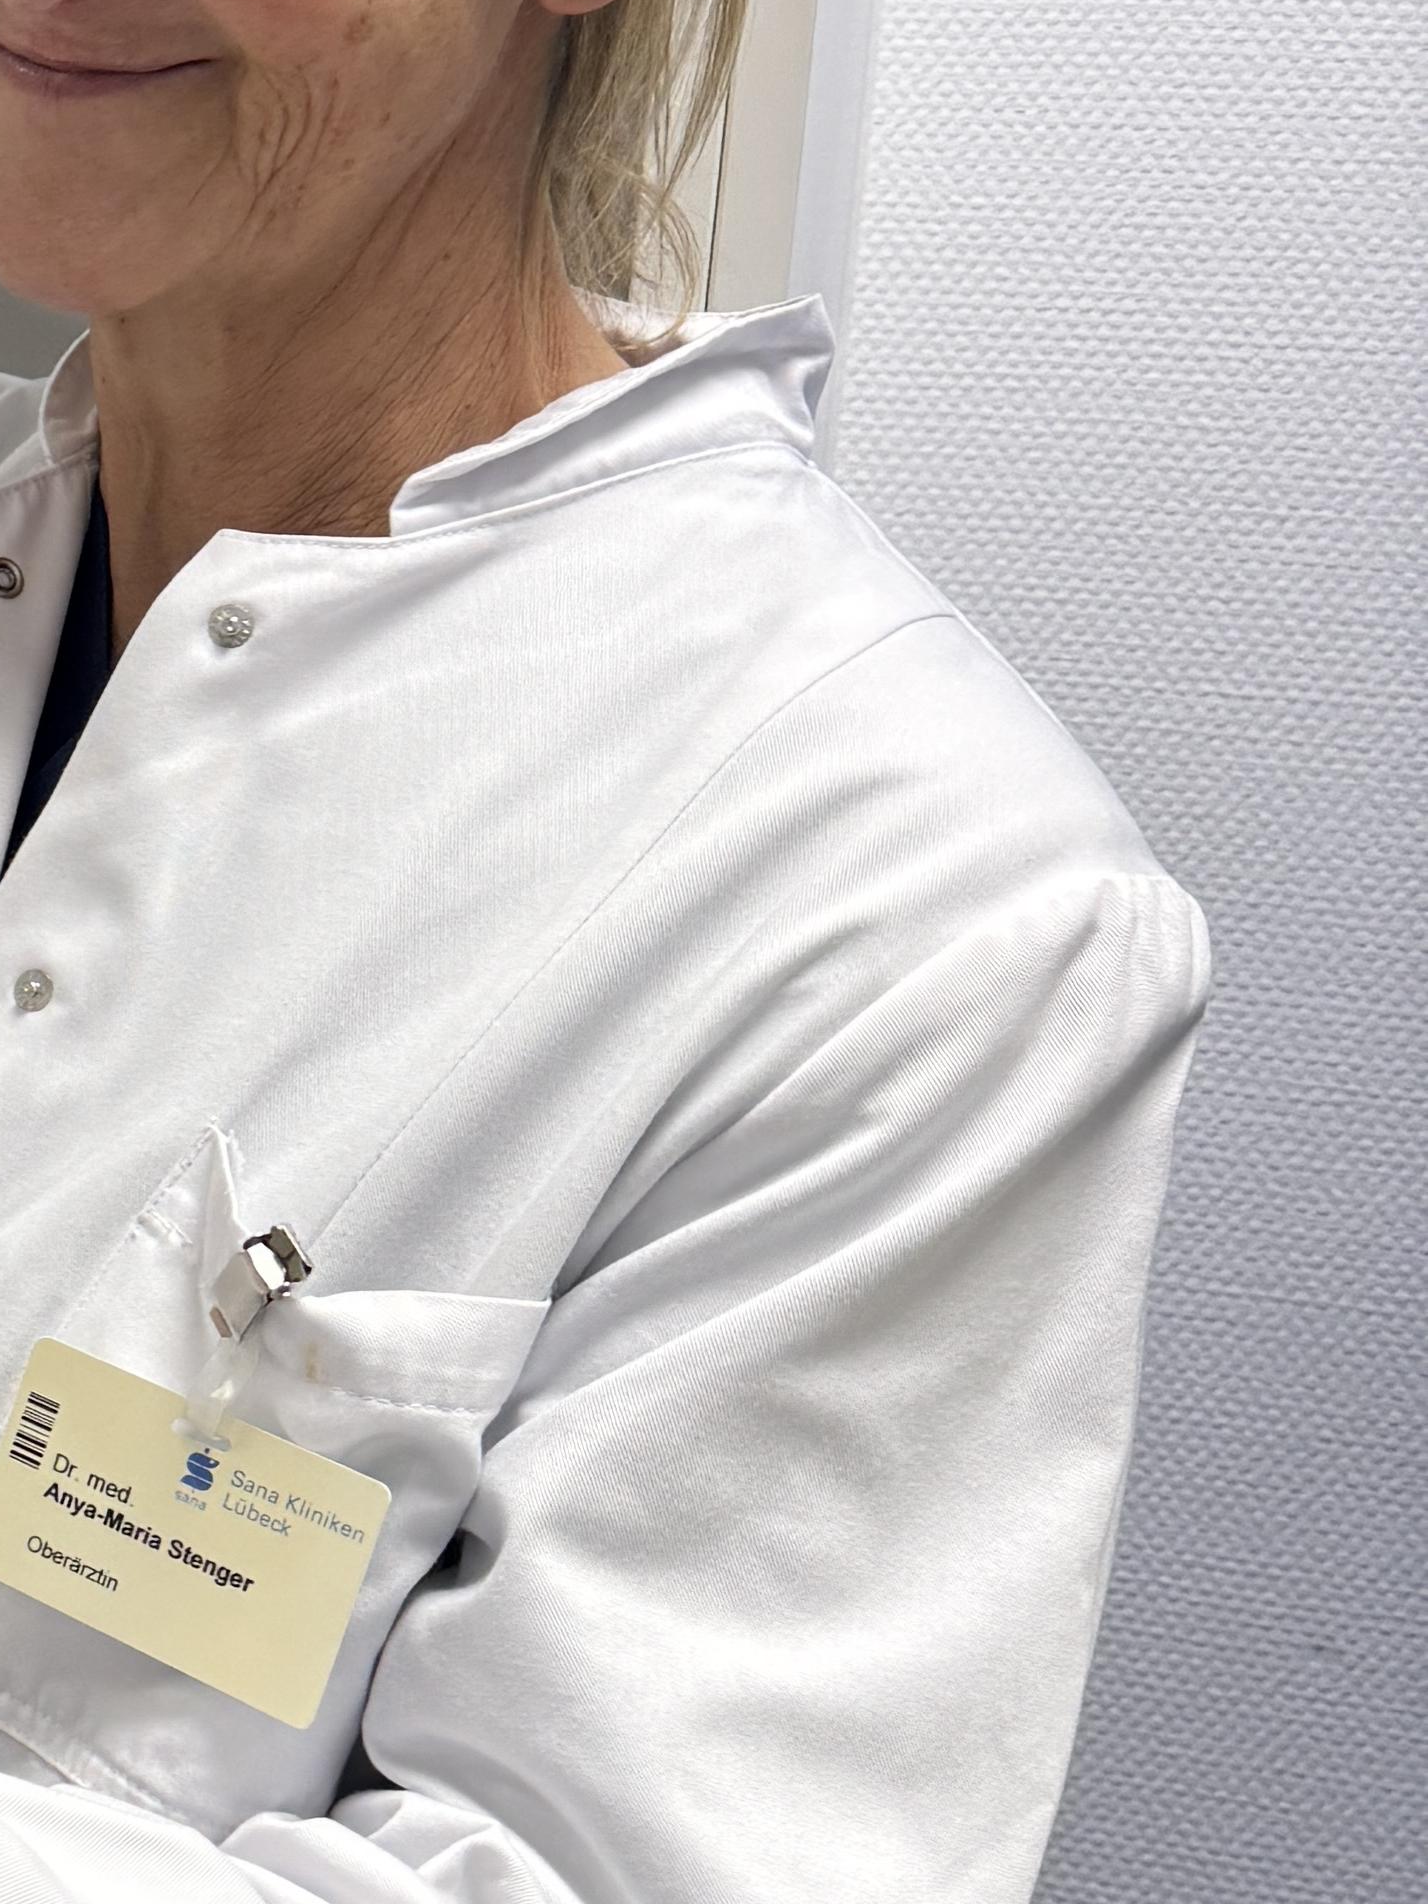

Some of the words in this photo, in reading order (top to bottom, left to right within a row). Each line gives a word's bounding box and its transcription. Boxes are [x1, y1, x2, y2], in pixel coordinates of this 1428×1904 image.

[53, 1453, 80, 1482] Dr.
[87, 1472, 134, 1507] med.
[231, 1469, 279, 1504] Sana
[286, 1496, 365, 1544] Kliniken
[44, 1483, 162, 1550] Anya-Maria
[168, 1540, 255, 1592] Stenger
[223, 1493, 292, 1537] Lübeck
[27, 1535, 118, 1592] Oberärztin
